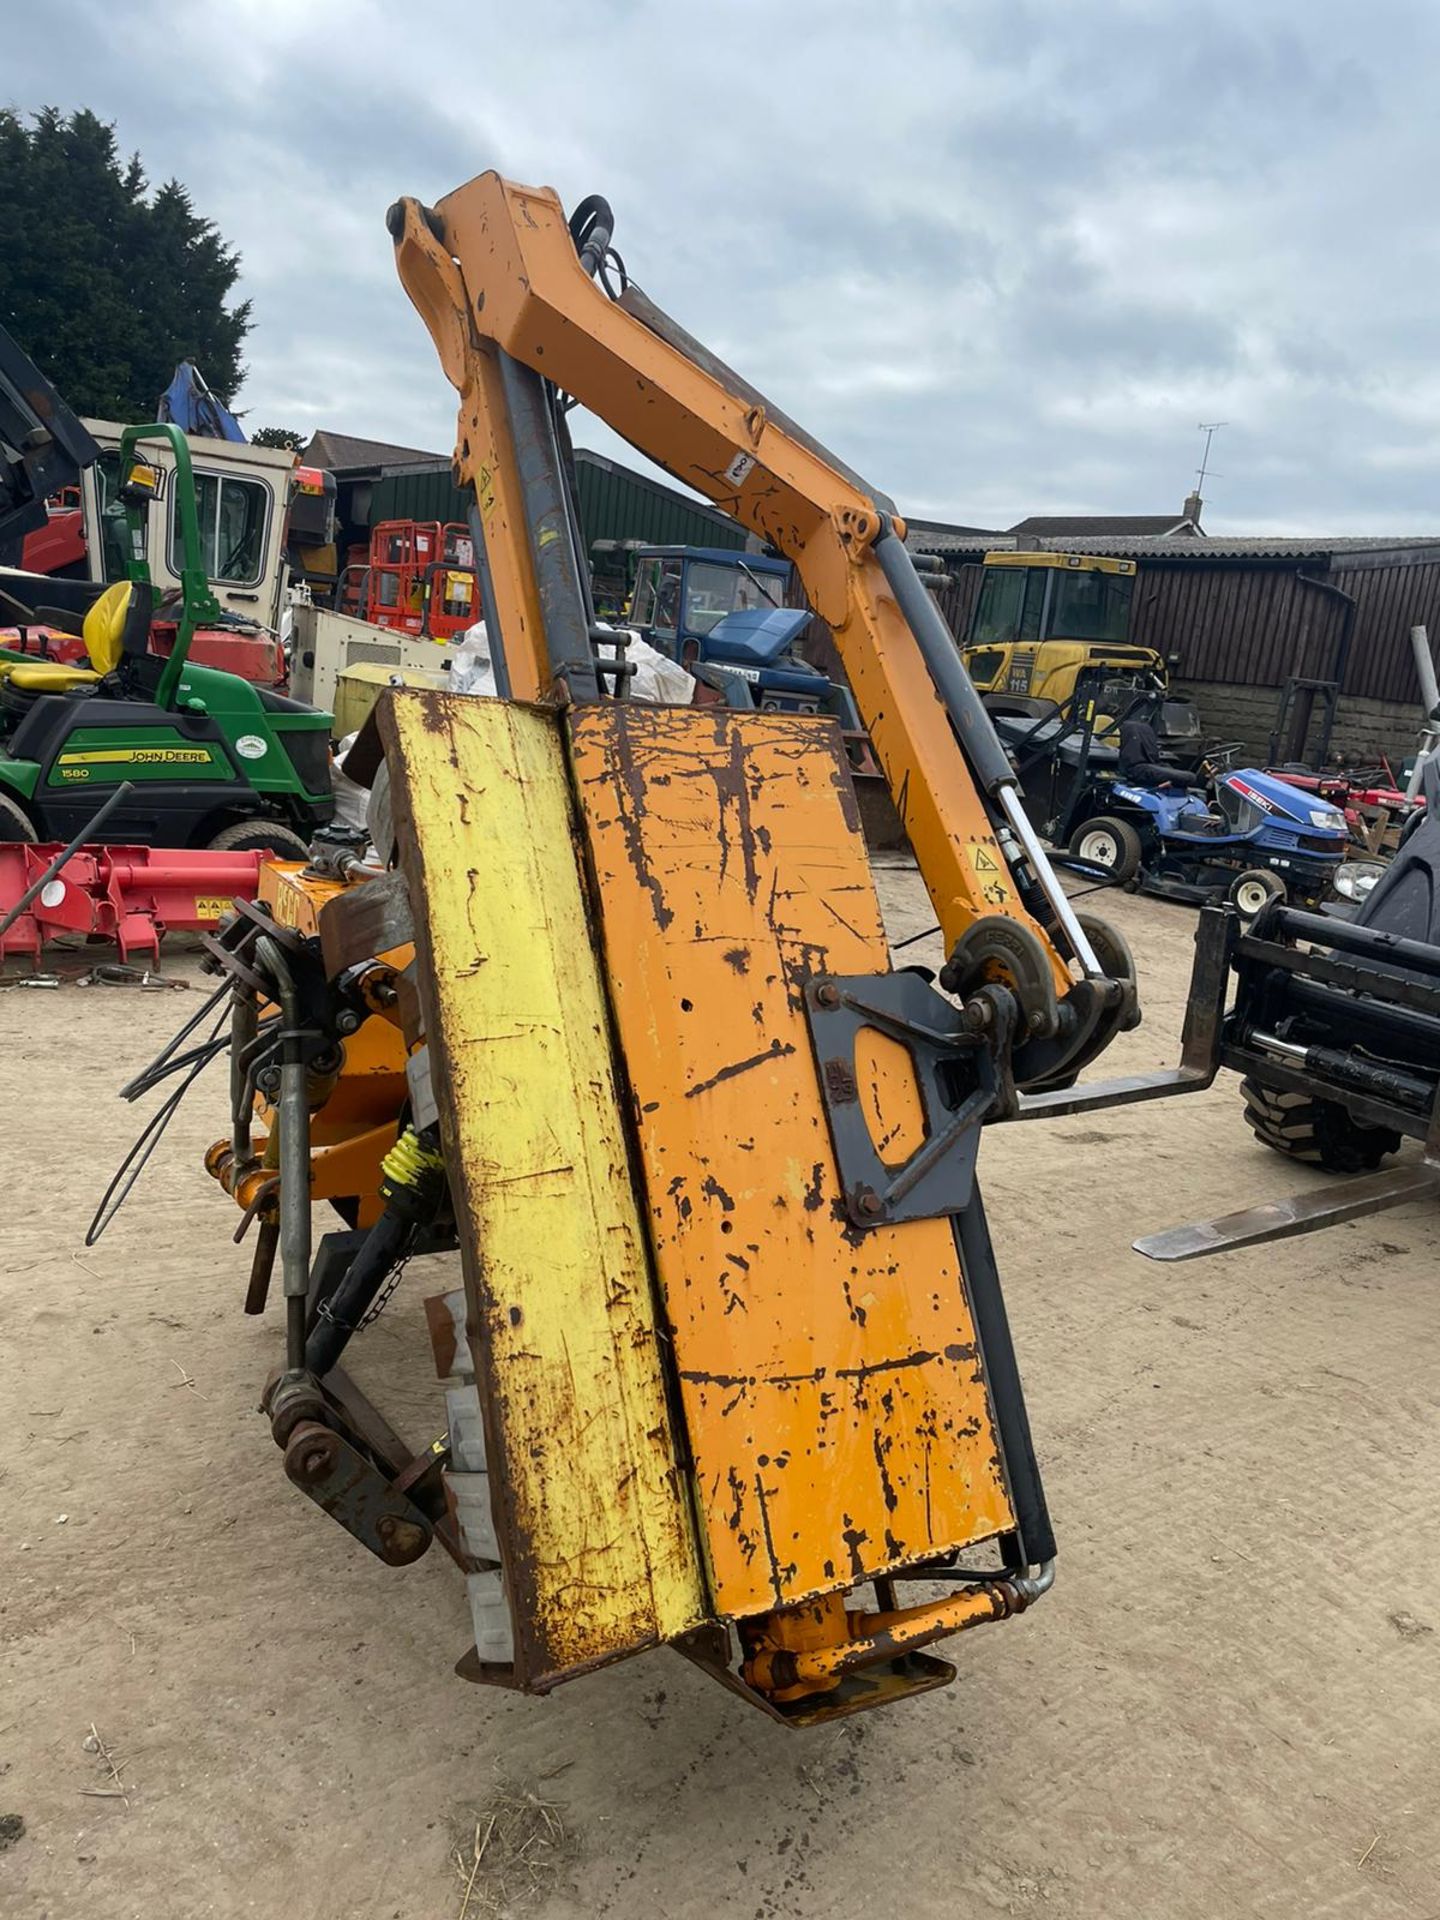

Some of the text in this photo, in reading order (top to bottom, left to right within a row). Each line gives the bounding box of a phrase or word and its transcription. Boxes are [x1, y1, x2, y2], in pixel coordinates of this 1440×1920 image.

[1010, 679, 1028, 692] 115
[129, 750, 206, 763] JOHN DEERE
[61, 769, 90, 778] 1580
[1247, 790, 1273, 811] ISEKI
[985, 930, 1024, 957] FERRI
